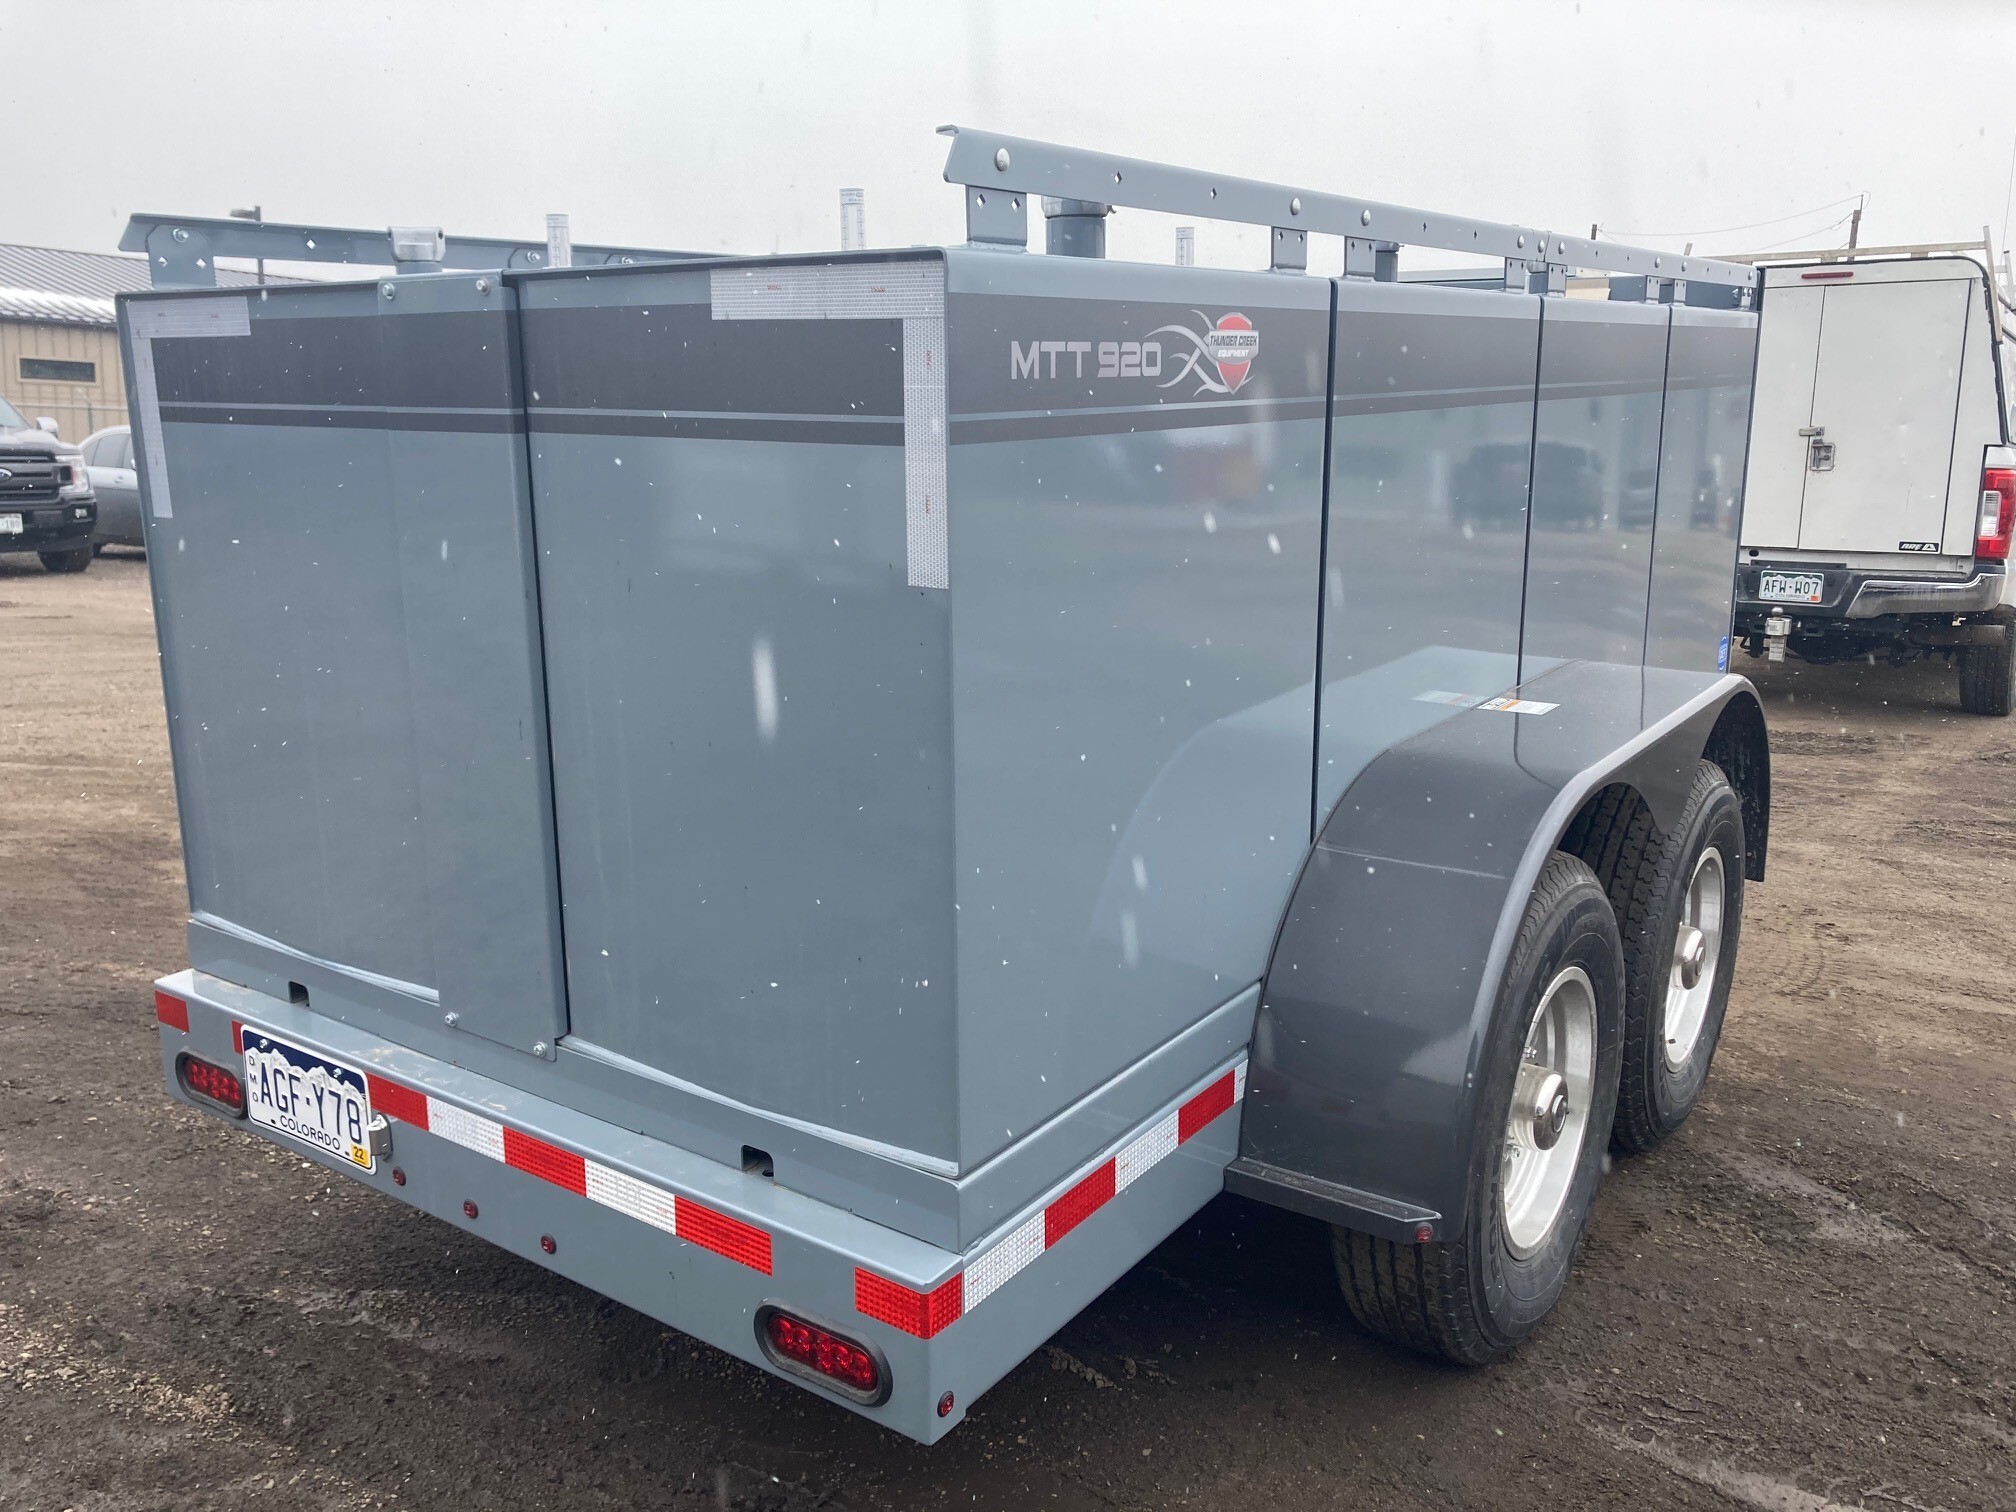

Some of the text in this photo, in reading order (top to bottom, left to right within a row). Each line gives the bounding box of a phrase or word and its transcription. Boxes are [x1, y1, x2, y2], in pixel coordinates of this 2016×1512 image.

[1210, 335, 1258, 347] THUNDER CREEK
[1010, 340, 1162, 380] MTT 920
[1217, 349, 1250, 359] EQUIPMENT
[280, 1115, 341, 1150] COLORADO
[353, 1145, 365, 1160] 22
